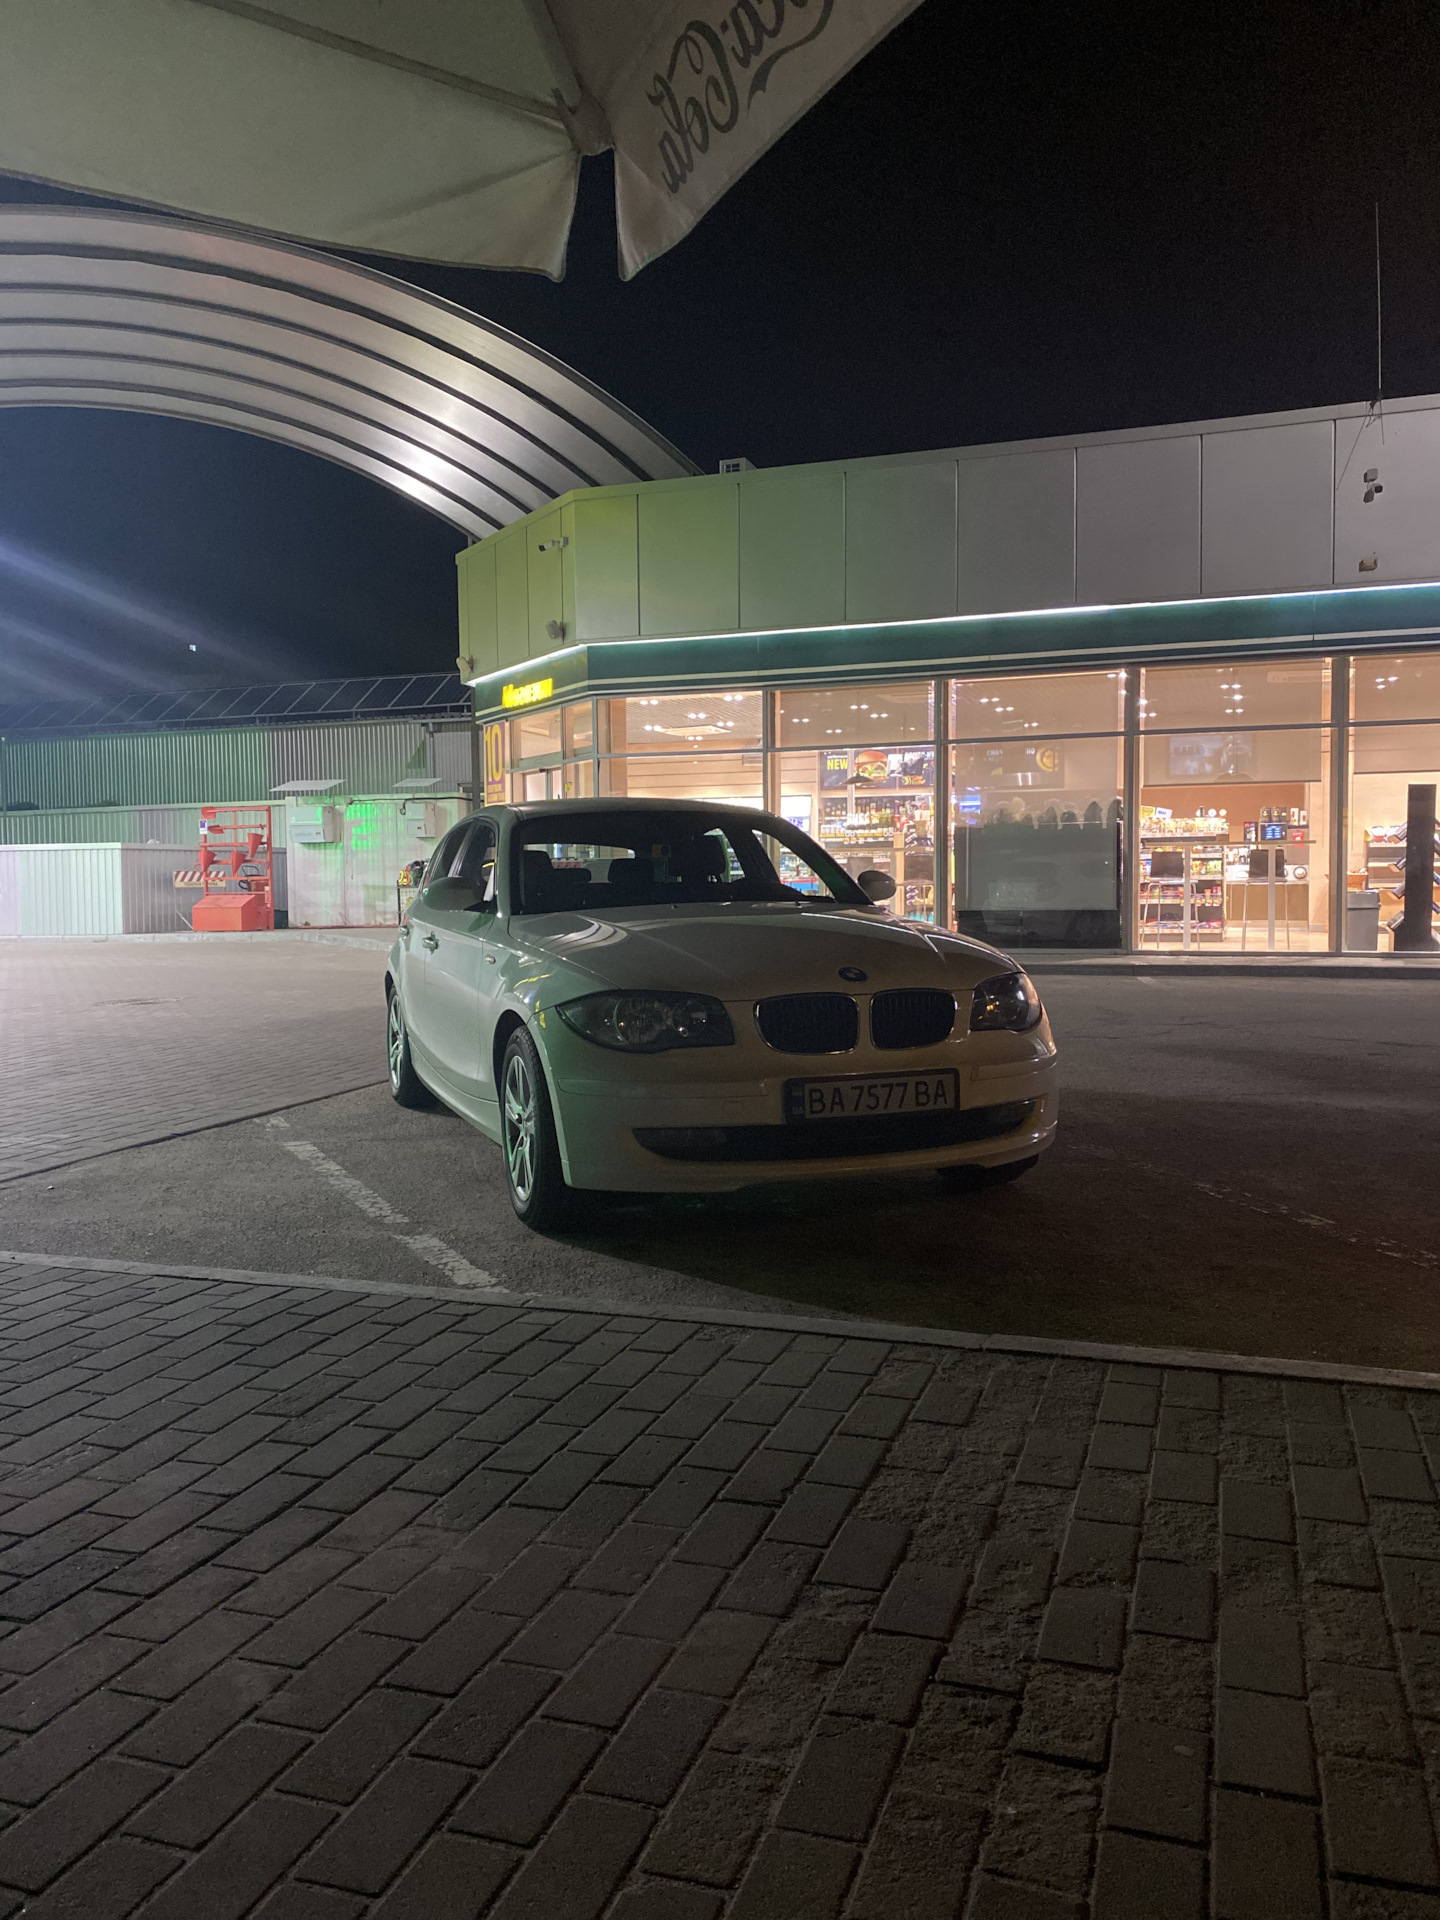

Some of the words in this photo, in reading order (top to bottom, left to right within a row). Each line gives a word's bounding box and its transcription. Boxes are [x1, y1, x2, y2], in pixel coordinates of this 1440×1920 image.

[484, 724, 502, 781] 10
[827, 758, 848, 771] NEW
[808, 1087, 845, 1115] BA
[850, 1082, 908, 1111] 7577
[914, 1079, 948, 1107] BA
